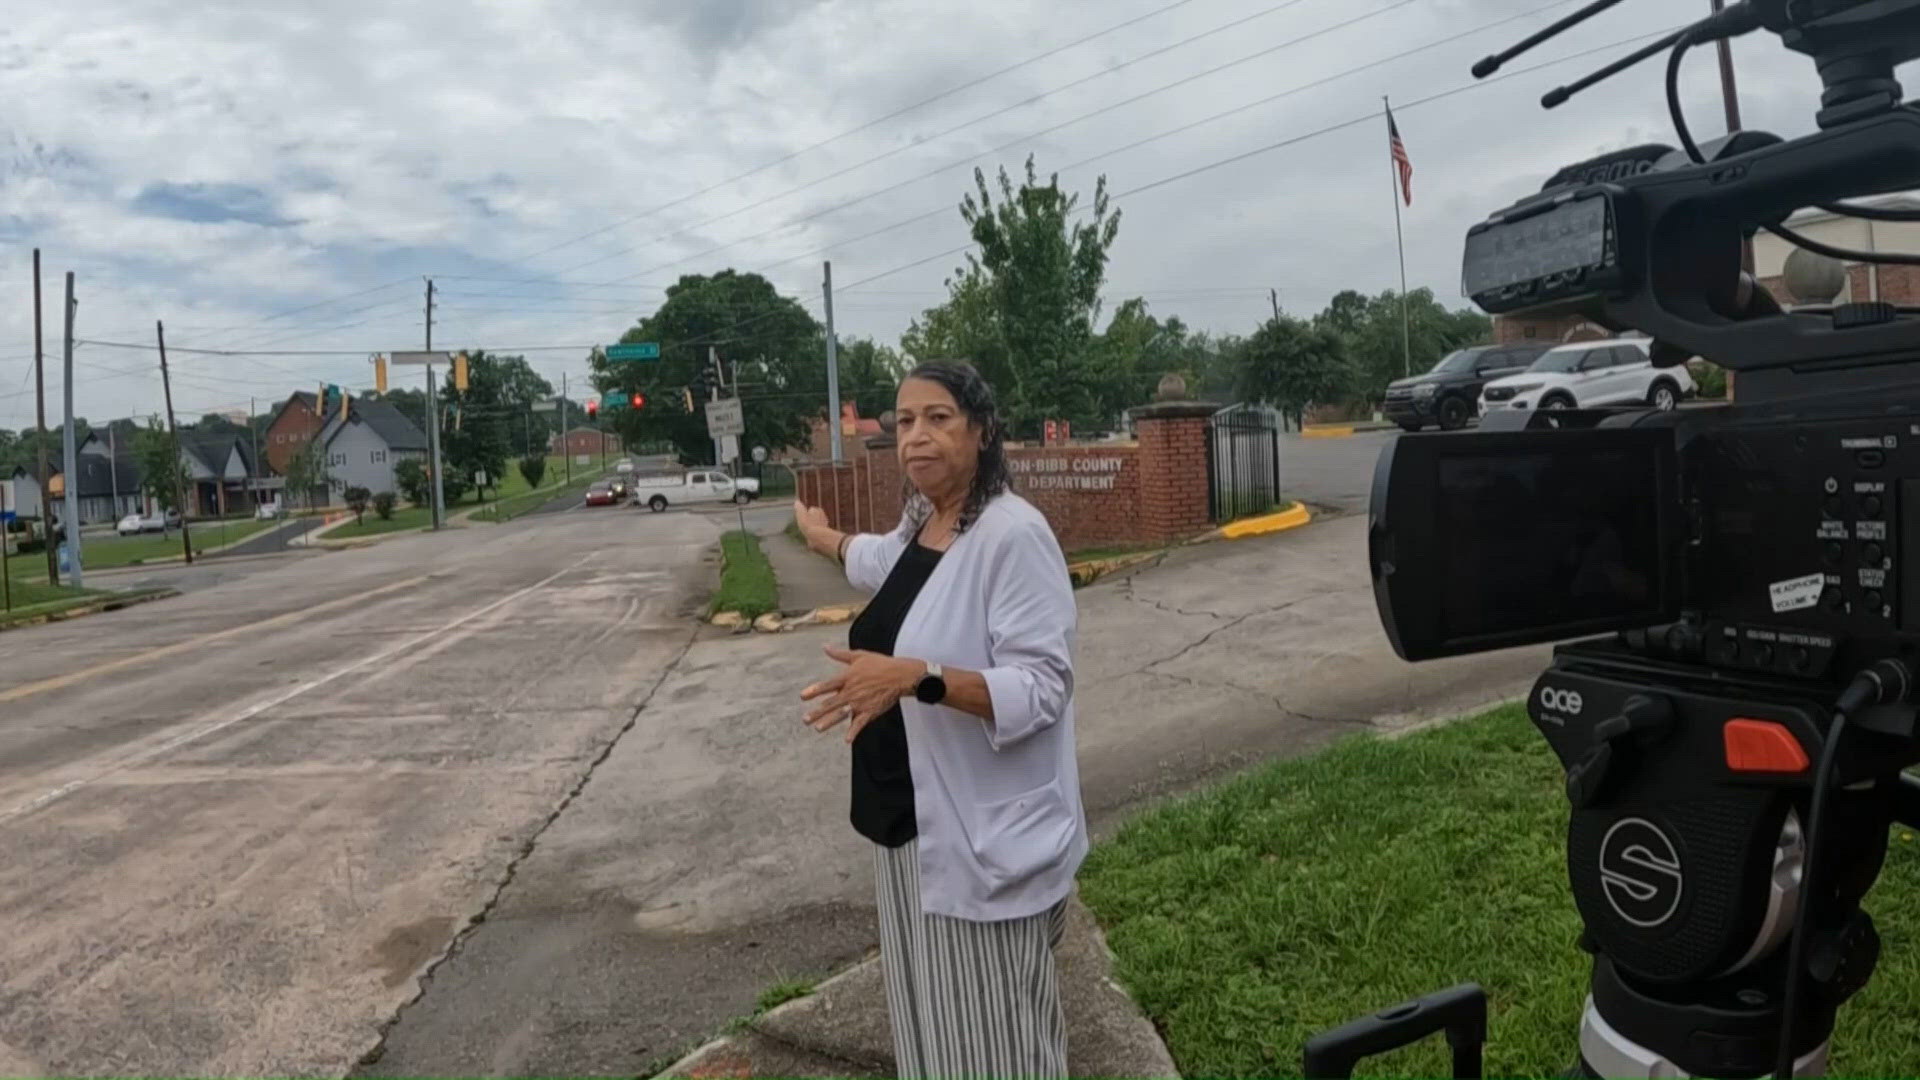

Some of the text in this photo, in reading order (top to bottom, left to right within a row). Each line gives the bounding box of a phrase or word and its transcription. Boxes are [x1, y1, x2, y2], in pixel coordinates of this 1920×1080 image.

[1008, 457, 1122, 473] ON-BIBB COUNTY
[1028, 475, 1115, 490] DEPARTMENT
[1854, 482, 1884, 493] DISPLAY
[1856, 520, 1886, 530] PICTURE
[1816, 529, 1849, 539] BALANCE
[1856, 529, 1886, 540] PROFILE
[1882, 557, 1892, 570] 3
[1773, 577, 1819, 595] HEADPHONE
[1859, 577, 1883, 588] CHECK
[1776, 595, 1806, 608] VOLUME
[1845, 601, 1851, 614] 1
[1882, 604, 1892, 618] 2
[1778, 633, 1831, 648] SHUTTER SPEED
[1541, 686, 1583, 715] ace
